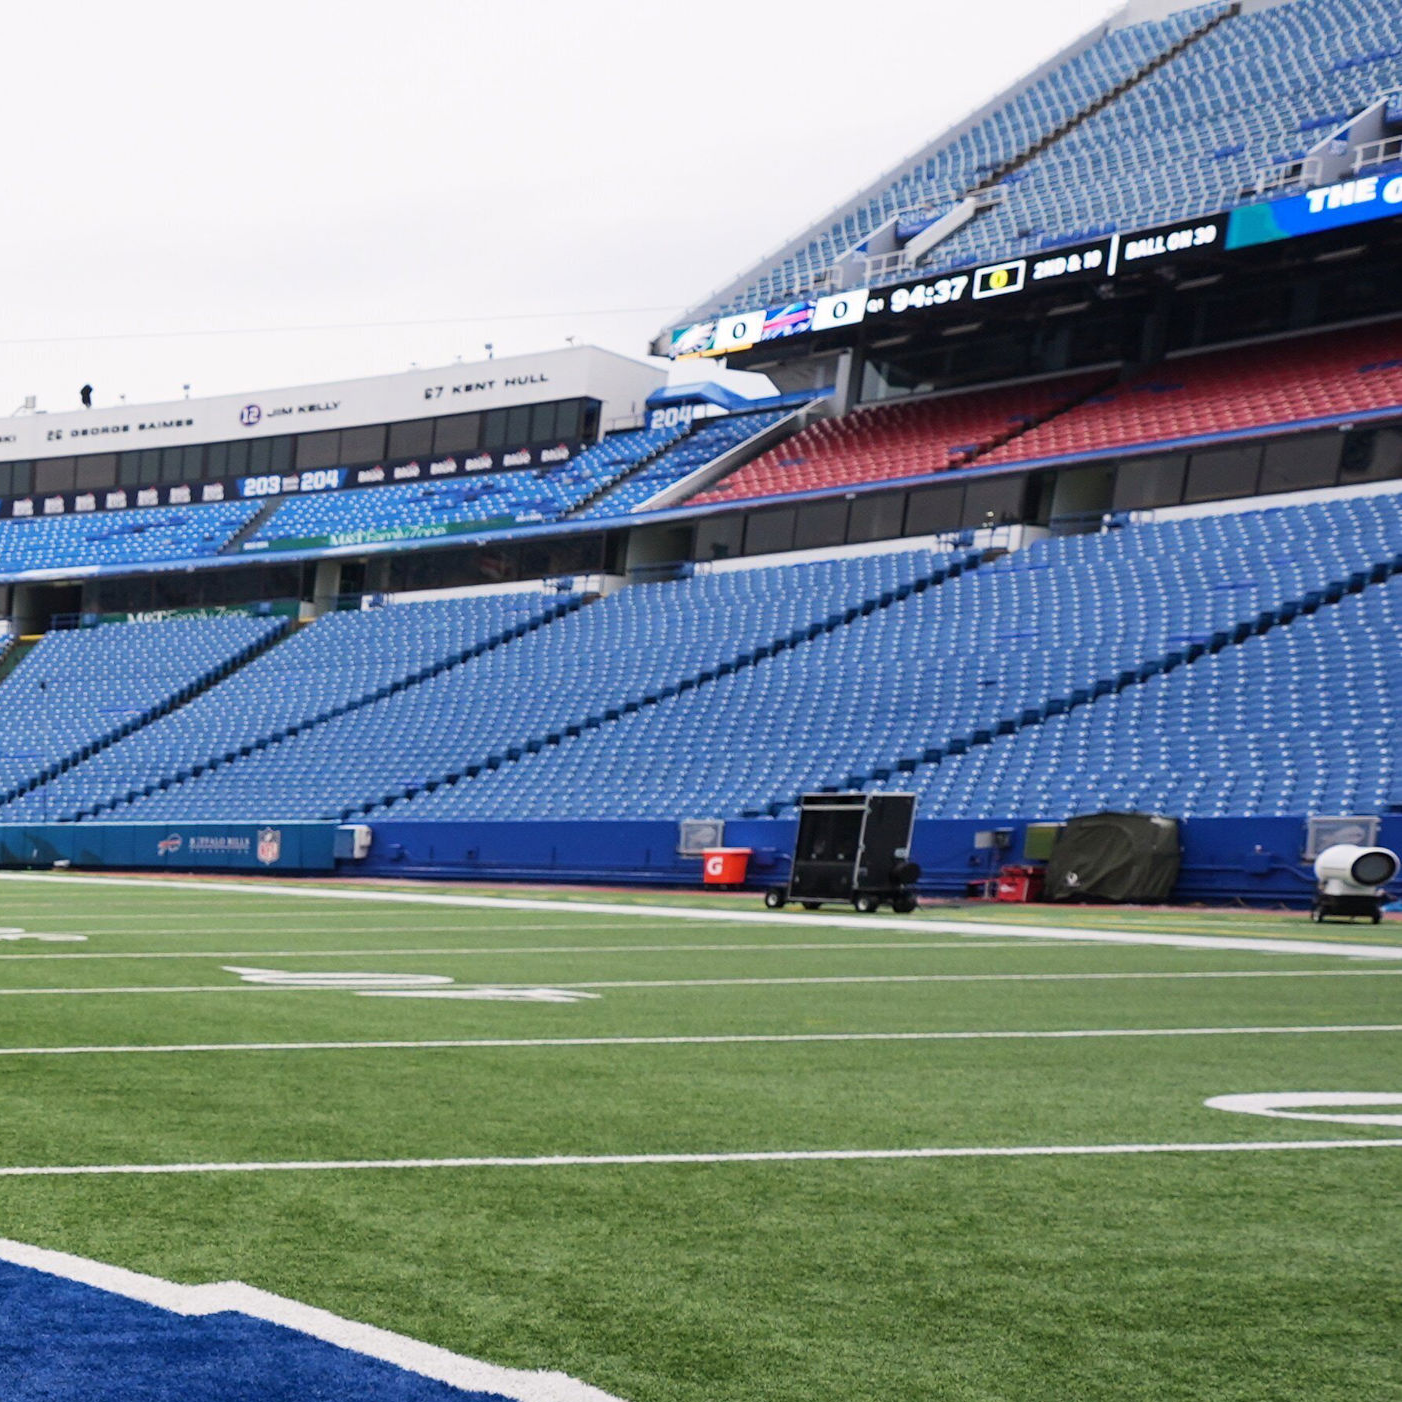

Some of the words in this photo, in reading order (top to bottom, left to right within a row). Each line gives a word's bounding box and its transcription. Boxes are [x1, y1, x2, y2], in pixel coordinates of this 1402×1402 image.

[1306, 176, 1379, 213] THE
[1124, 235, 1166, 260] BALL
[890, 275, 969, 312] 94:37
[833, 301, 847, 318] 0
[732, 322, 746, 338] 0
[452, 380, 495, 394] KENT
[505, 374, 548, 387] HULL
[267, 407, 292, 418] JIM
[298, 401, 340, 414] KELLY
[651, 405, 693, 429] 204
[70, 424, 130, 437] GEORGE
[138, 418, 194, 431] SAIMES
[244, 476, 281, 497] 203
[300, 470, 339, 491] 204
[706, 856, 724, 876] G
